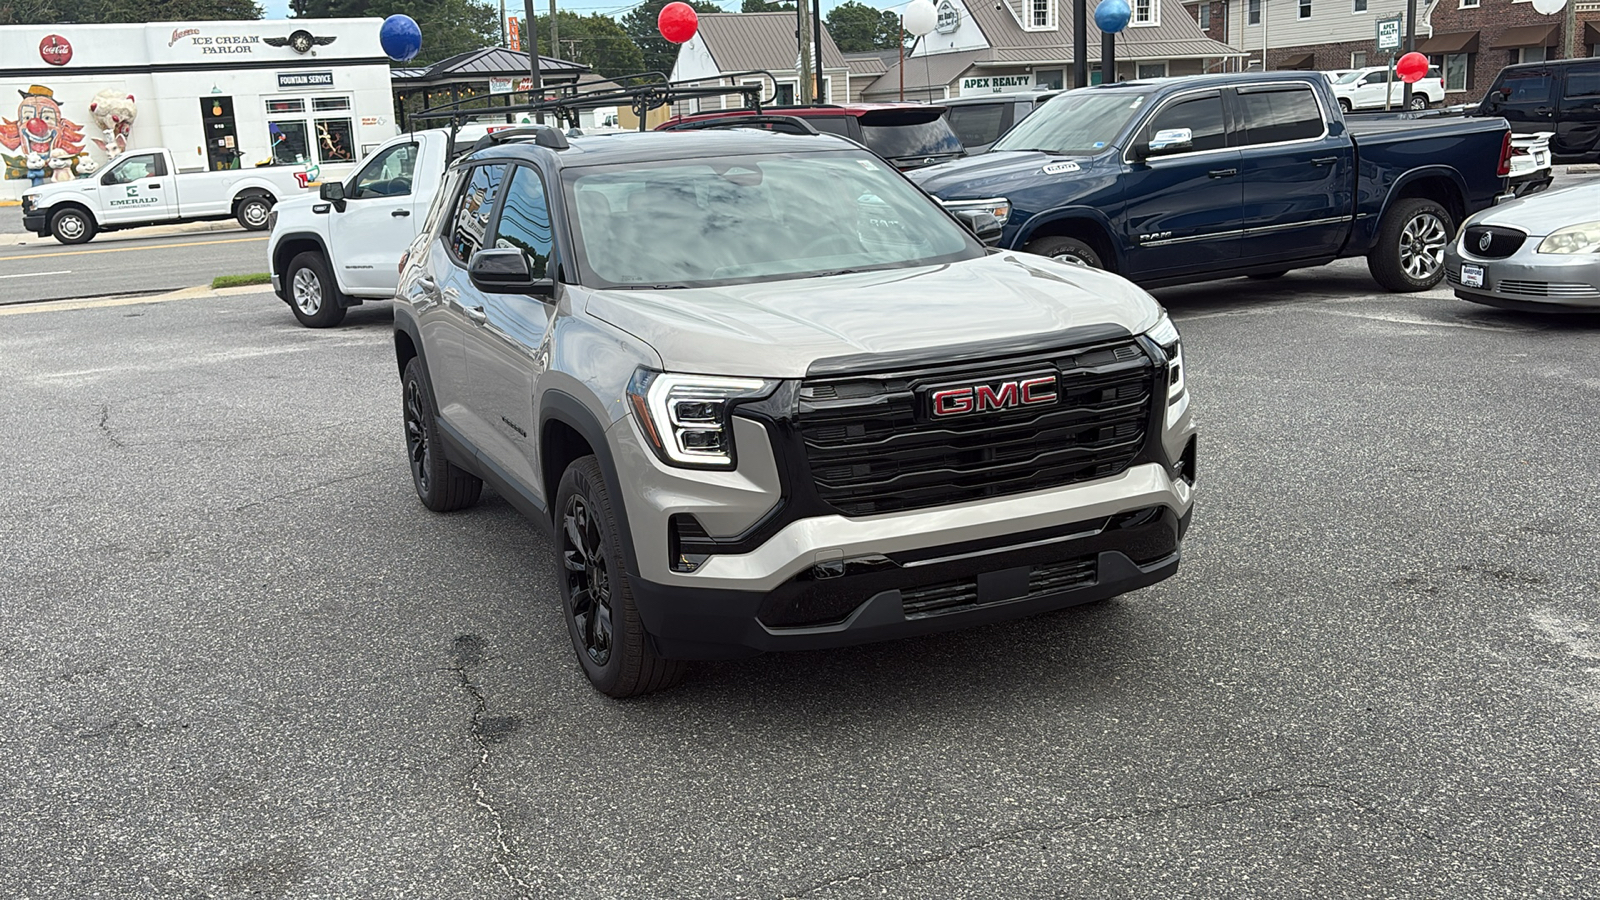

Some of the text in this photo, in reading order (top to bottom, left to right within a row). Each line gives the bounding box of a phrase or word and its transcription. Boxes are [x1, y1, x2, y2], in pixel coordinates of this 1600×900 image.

[192, 36, 260, 45] ICE CREAM
[202, 45, 252, 54] PARLOR
[280, 74, 332, 85] FOUNTAIN SERVICE
[964, 76, 1030, 89] APEX REALTY
[110, 197, 158, 206] EMERALD
[1140, 231, 1172, 240] RAM
[932, 375, 1057, 417] GMC
